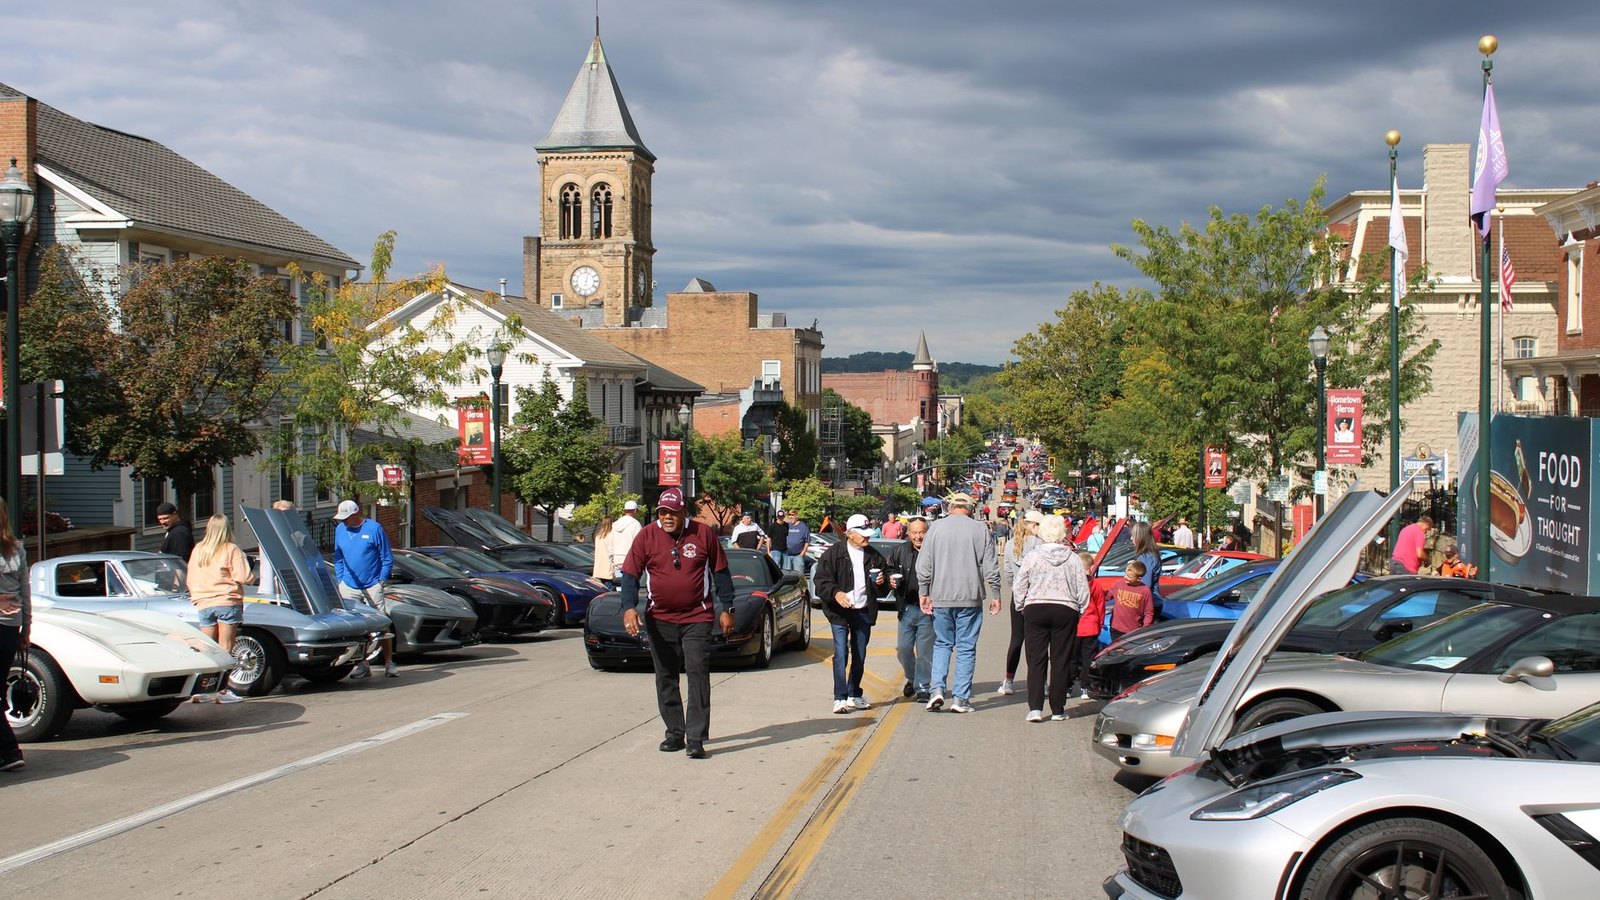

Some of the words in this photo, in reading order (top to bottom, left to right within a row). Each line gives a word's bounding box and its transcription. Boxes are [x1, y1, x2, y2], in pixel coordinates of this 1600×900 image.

[1328, 395, 1361, 406] Hometown
[1539, 451, 1581, 488] FOOD
[1550, 494, 1566, 513] FOR
[1537, 516, 1581, 546] THOUGHT
